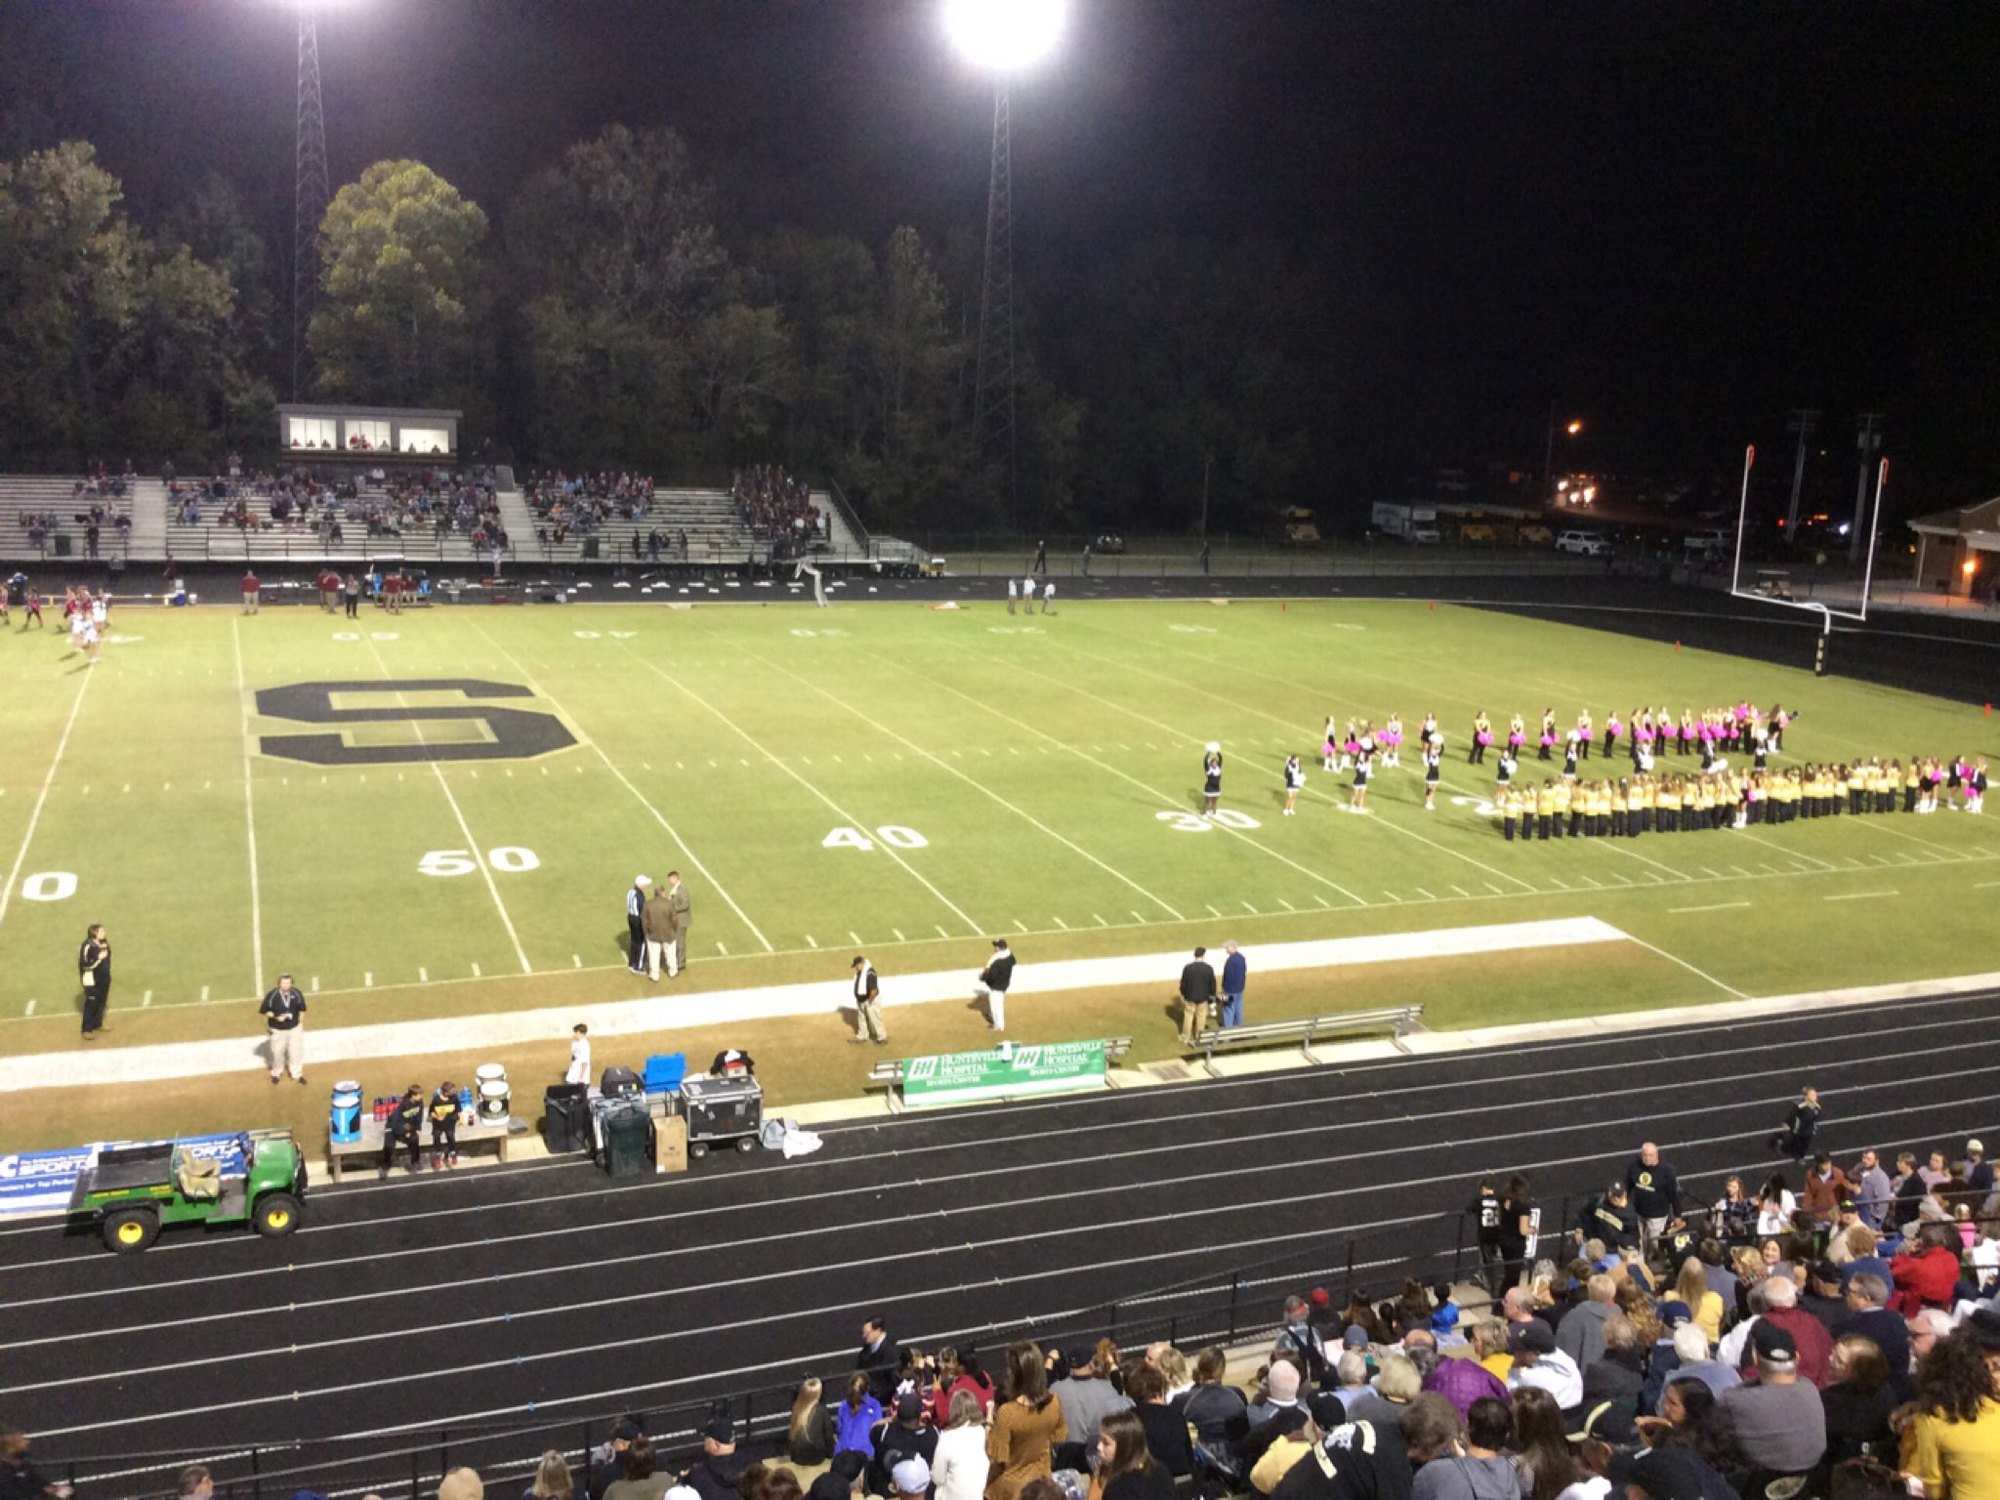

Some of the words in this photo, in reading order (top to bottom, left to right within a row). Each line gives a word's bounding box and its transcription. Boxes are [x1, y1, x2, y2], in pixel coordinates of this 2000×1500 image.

[255, 678, 579, 765] S
[1155, 809, 1262, 832] 30
[821, 825, 929, 852] 40
[418, 845, 541, 877] 50
[1045, 1041, 1100, 1056] HUNTSVILLE
[1045, 1053, 1089, 1067] HOSPITAL
[941, 1063, 989, 1077] HOSPITAL
